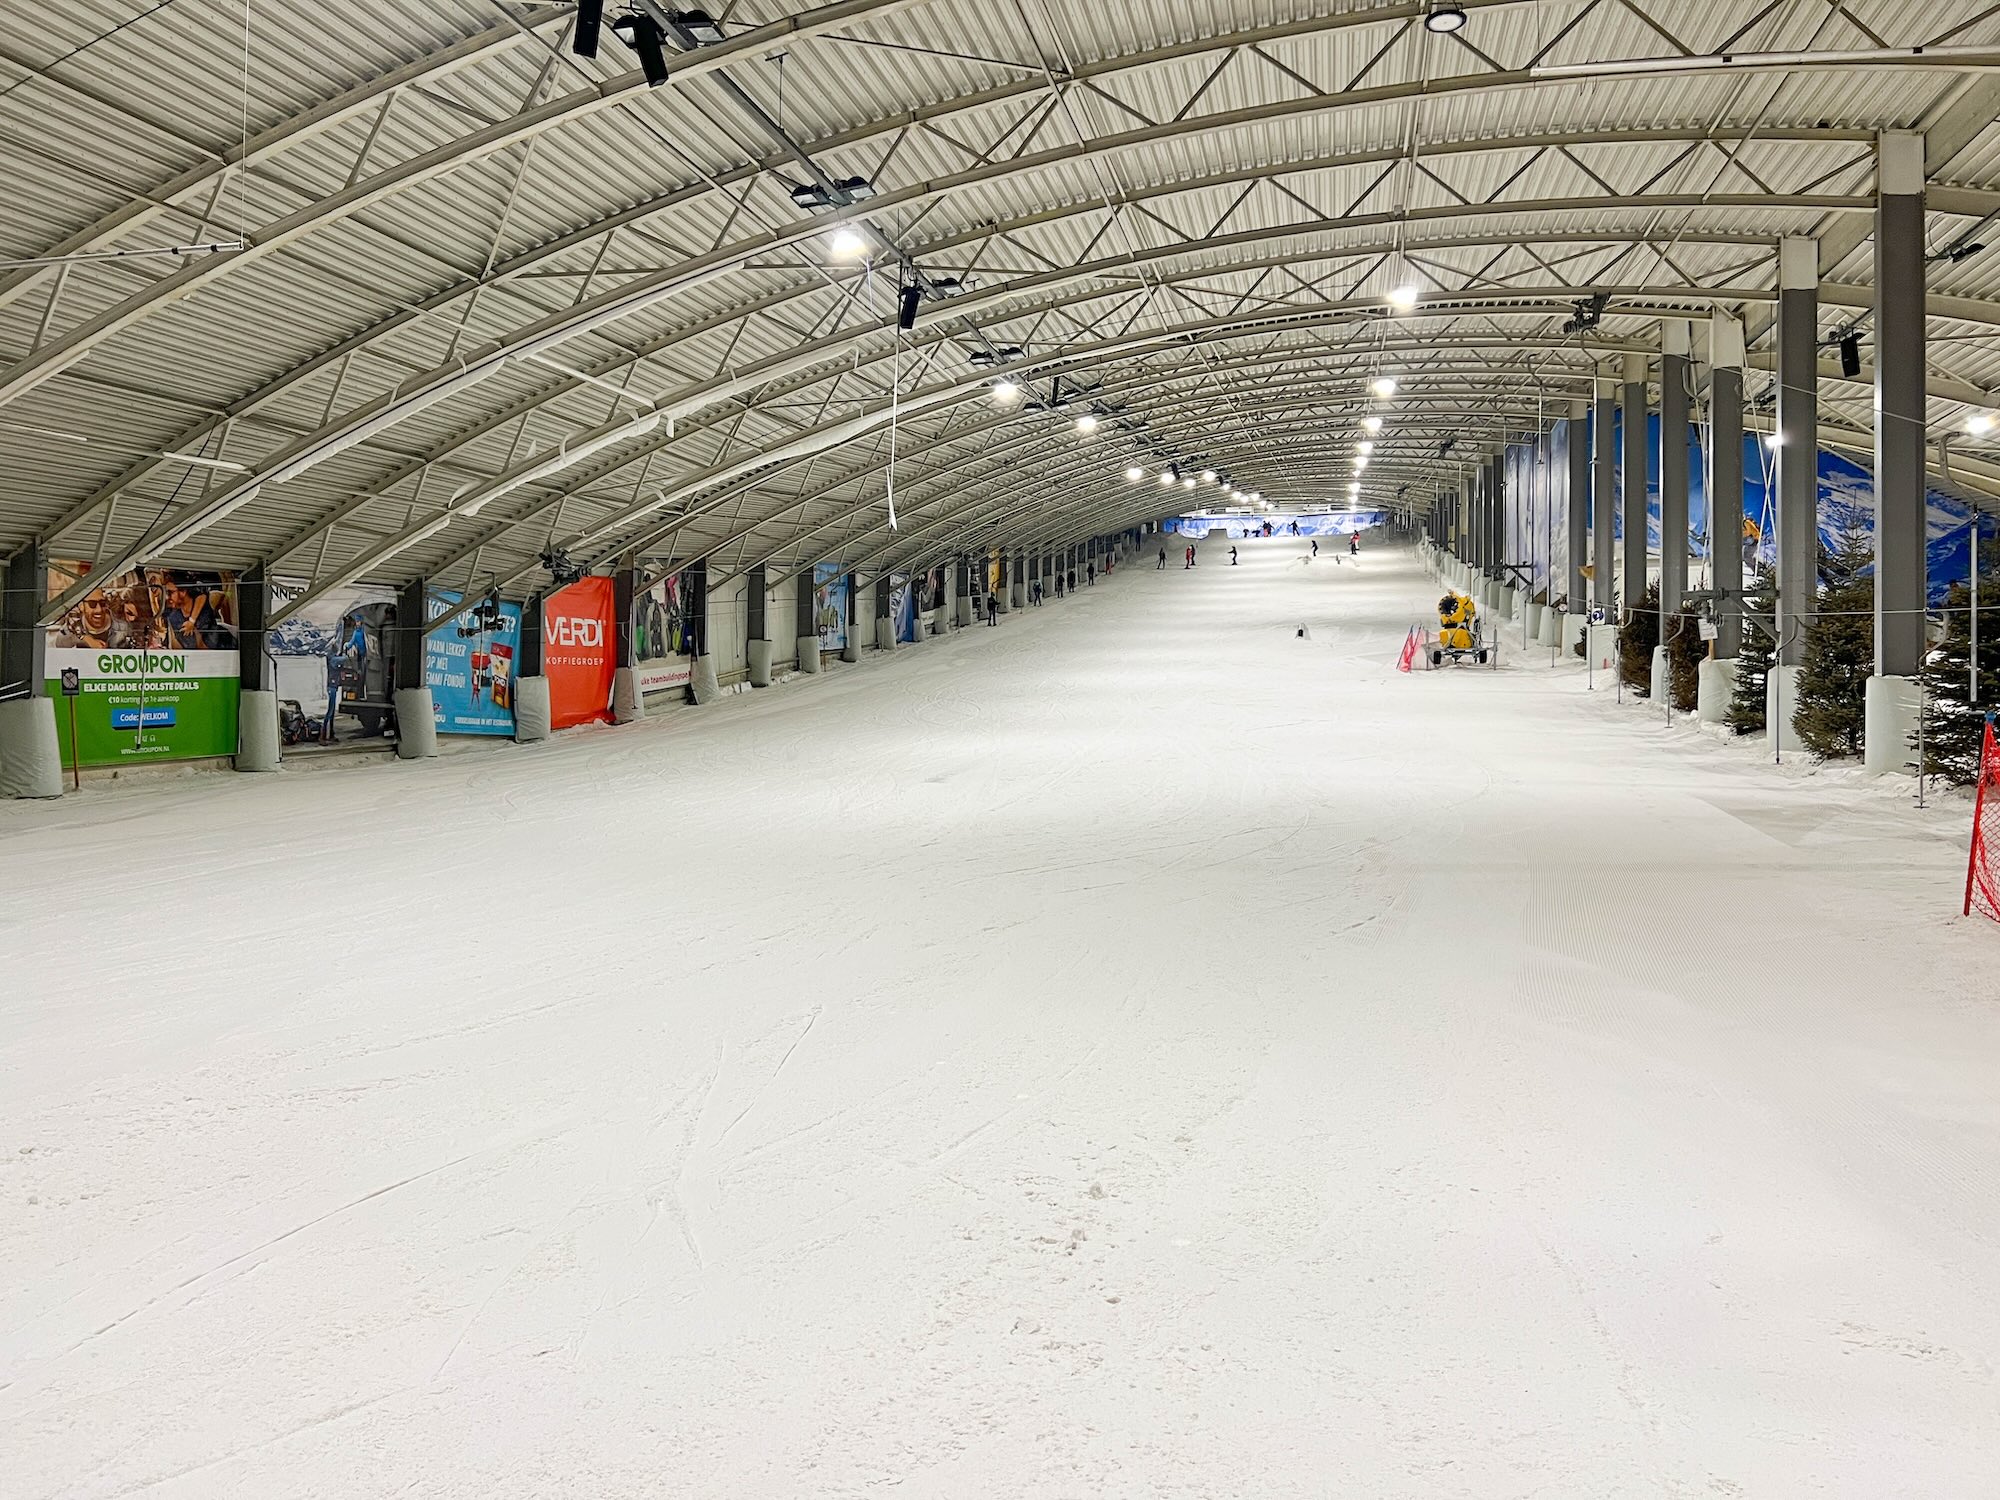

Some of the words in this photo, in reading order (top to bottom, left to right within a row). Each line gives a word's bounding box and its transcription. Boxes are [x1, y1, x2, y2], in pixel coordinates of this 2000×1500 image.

[545, 616, 603, 647] VERDI
[427, 639, 445, 654] WARM
[446, 642, 467, 657] LEKKER
[98, 654, 185, 673] GROUPON
[426, 655, 436, 669] OP
[436, 657, 448, 670] MET
[546, 656, 604, 666] KOFFIEGROEP
[84, 683, 106, 692] ELKE
[108, 683, 125, 692] DAG
[126, 683, 137, 691] DE
[174, 682, 199, 690] DEALS
[108, 696, 119, 704] €10
[120, 713, 139, 721] Code:
[141, 712, 168, 721] WELKOM
